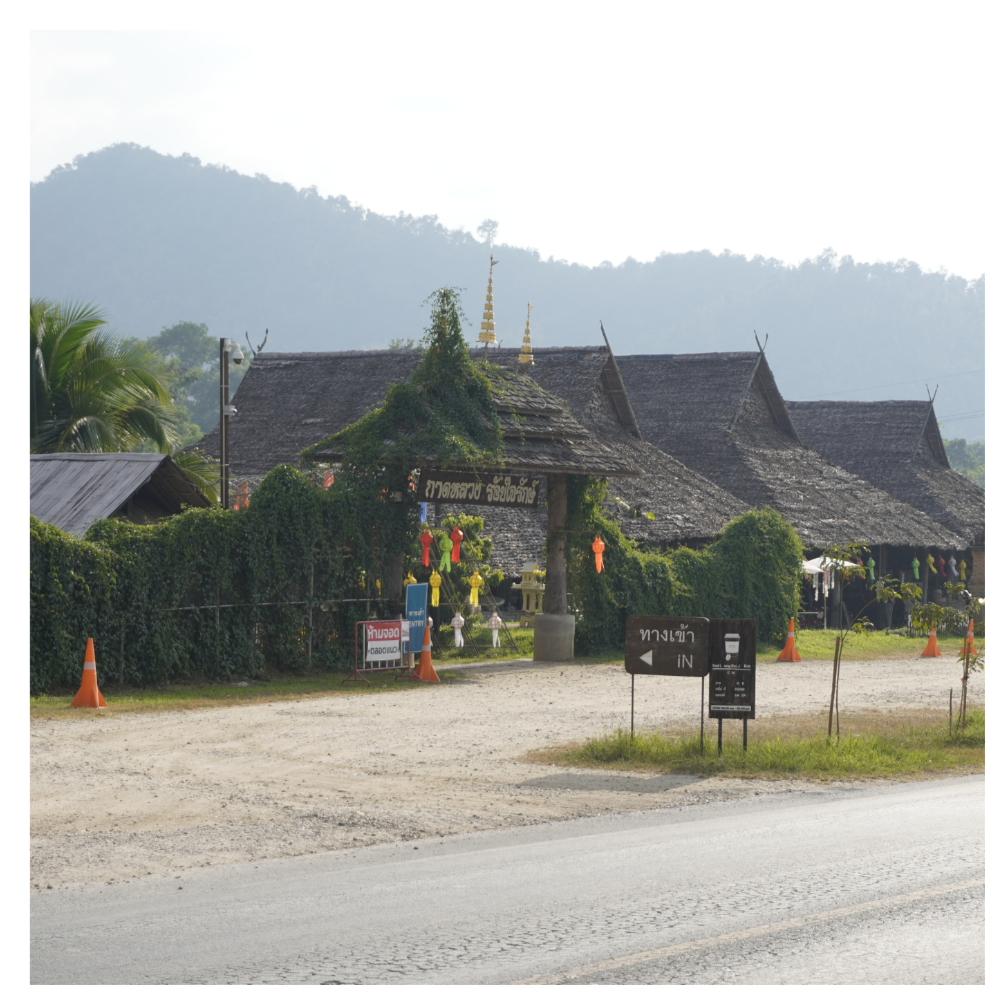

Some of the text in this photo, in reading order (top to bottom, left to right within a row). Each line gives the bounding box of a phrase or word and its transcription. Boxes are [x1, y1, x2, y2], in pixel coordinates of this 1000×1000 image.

[367, 624, 400, 639] ห้ามจอด
[639, 623, 695, 643] ทางเข้า
[677, 653, 693, 669] IN
